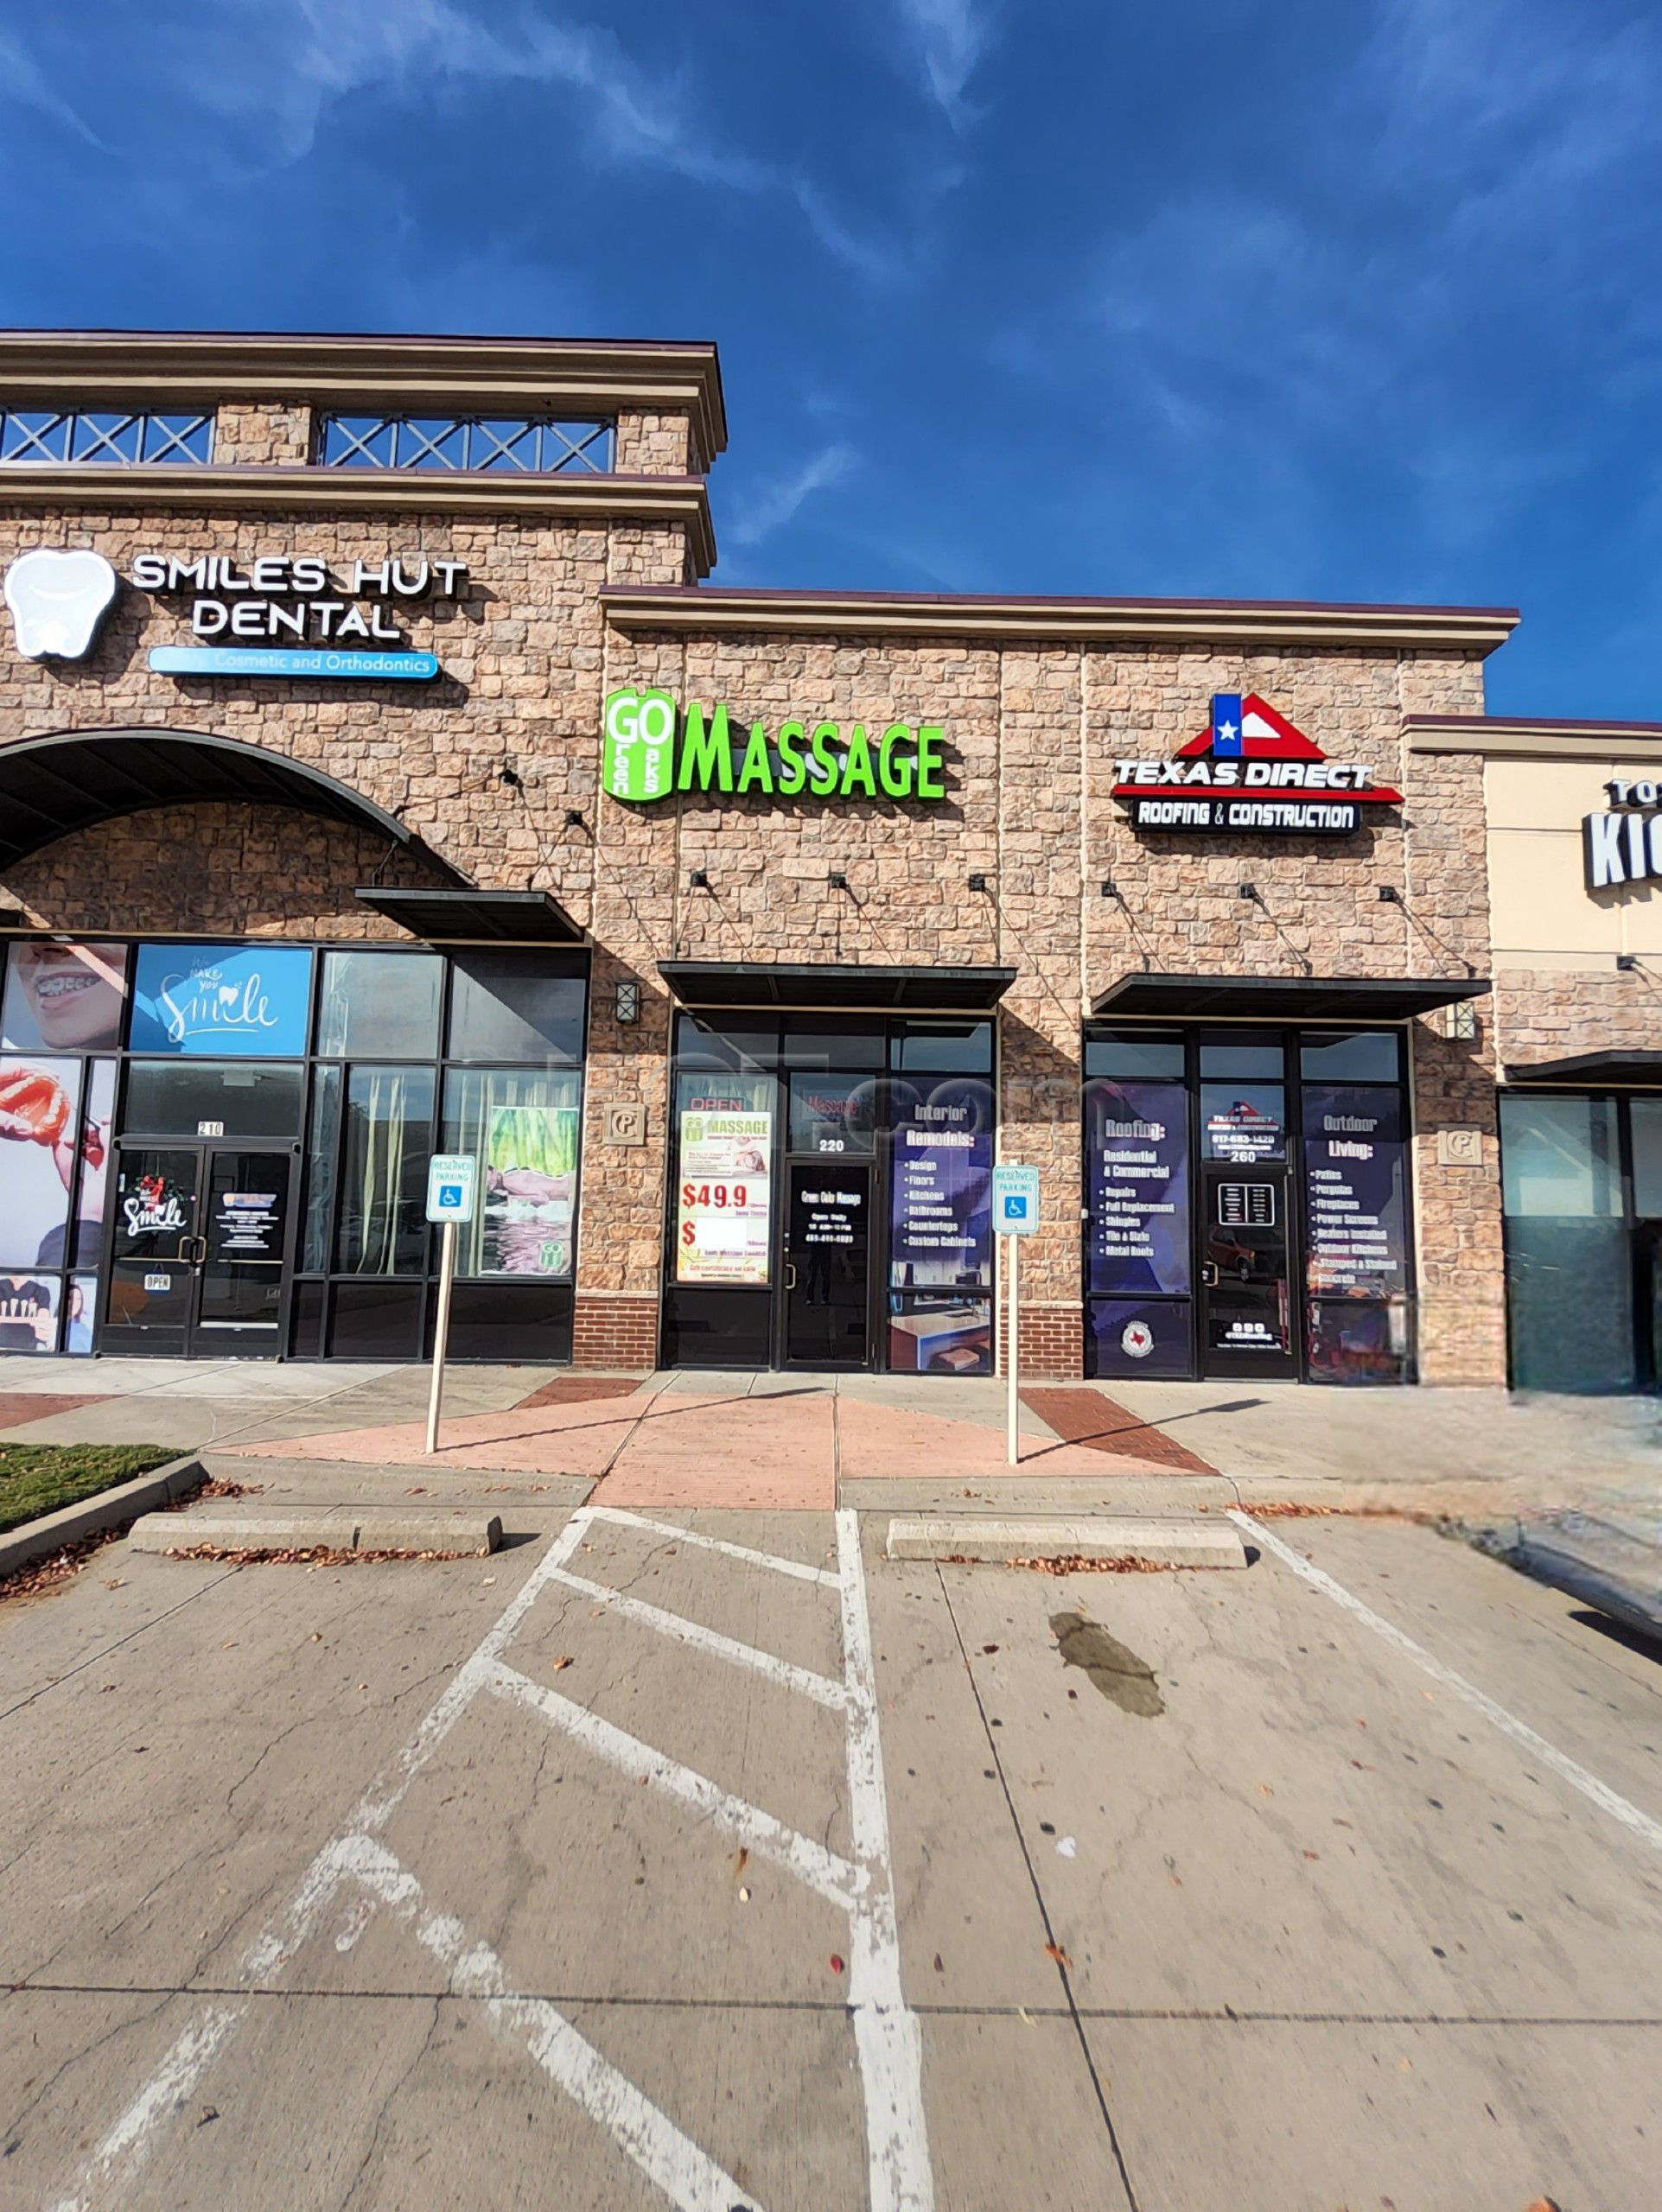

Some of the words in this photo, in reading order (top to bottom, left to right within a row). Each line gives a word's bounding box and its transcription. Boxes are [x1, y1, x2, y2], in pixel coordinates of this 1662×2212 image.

[132, 554, 326, 592] SMILES
[353, 559, 467, 594] HUT
[193, 600, 400, 639] DENTAL
[214, 650, 287, 669] Cosmetic
[292, 653, 321, 670] and
[326, 655, 430, 673] Orthodontics
[608, 697, 673, 745] GO
[678, 703, 945, 798] MASSAGE
[1115, 760, 1239, 785] TEXAS
[1245, 762, 1372, 789] DIRECT
[1608, 779, 1662, 805] TO
[1138, 801, 1210, 825] ROOFING
[1214, 803, 1224, 824] &
[1229, 804, 1353, 828] CONSTRUCTION
[691, 1097, 742, 1110] OPEN
[914, 1105, 967, 1121] Interior
[707, 1120, 767, 1134] MASSAGE
[1105, 1120, 1166, 1141] Roofing:
[1323, 1115, 1377, 1132] Outdoor
[819, 1140, 844, 1152] 220
[907, 1130, 975, 1147] Remodels:
[1231, 1151, 1256, 1162] 260
[1329, 1141, 1373, 1160] Living:
[909, 1160, 937, 1171] Design
[909, 1176, 934, 1185] Floors
[996, 1172, 1035, 1180] RESERVED
[683, 1183, 747, 1209] $49.9
[909, 1191, 945, 1201] Kitchens
[999, 1183, 1032, 1192] PARKING
[124, 1198, 187, 1236] Smile
[909, 1205, 952, 1217] Bathrooms
[682, 1220, 696, 1246] $
[147, 1277, 169, 1288] OPEN
